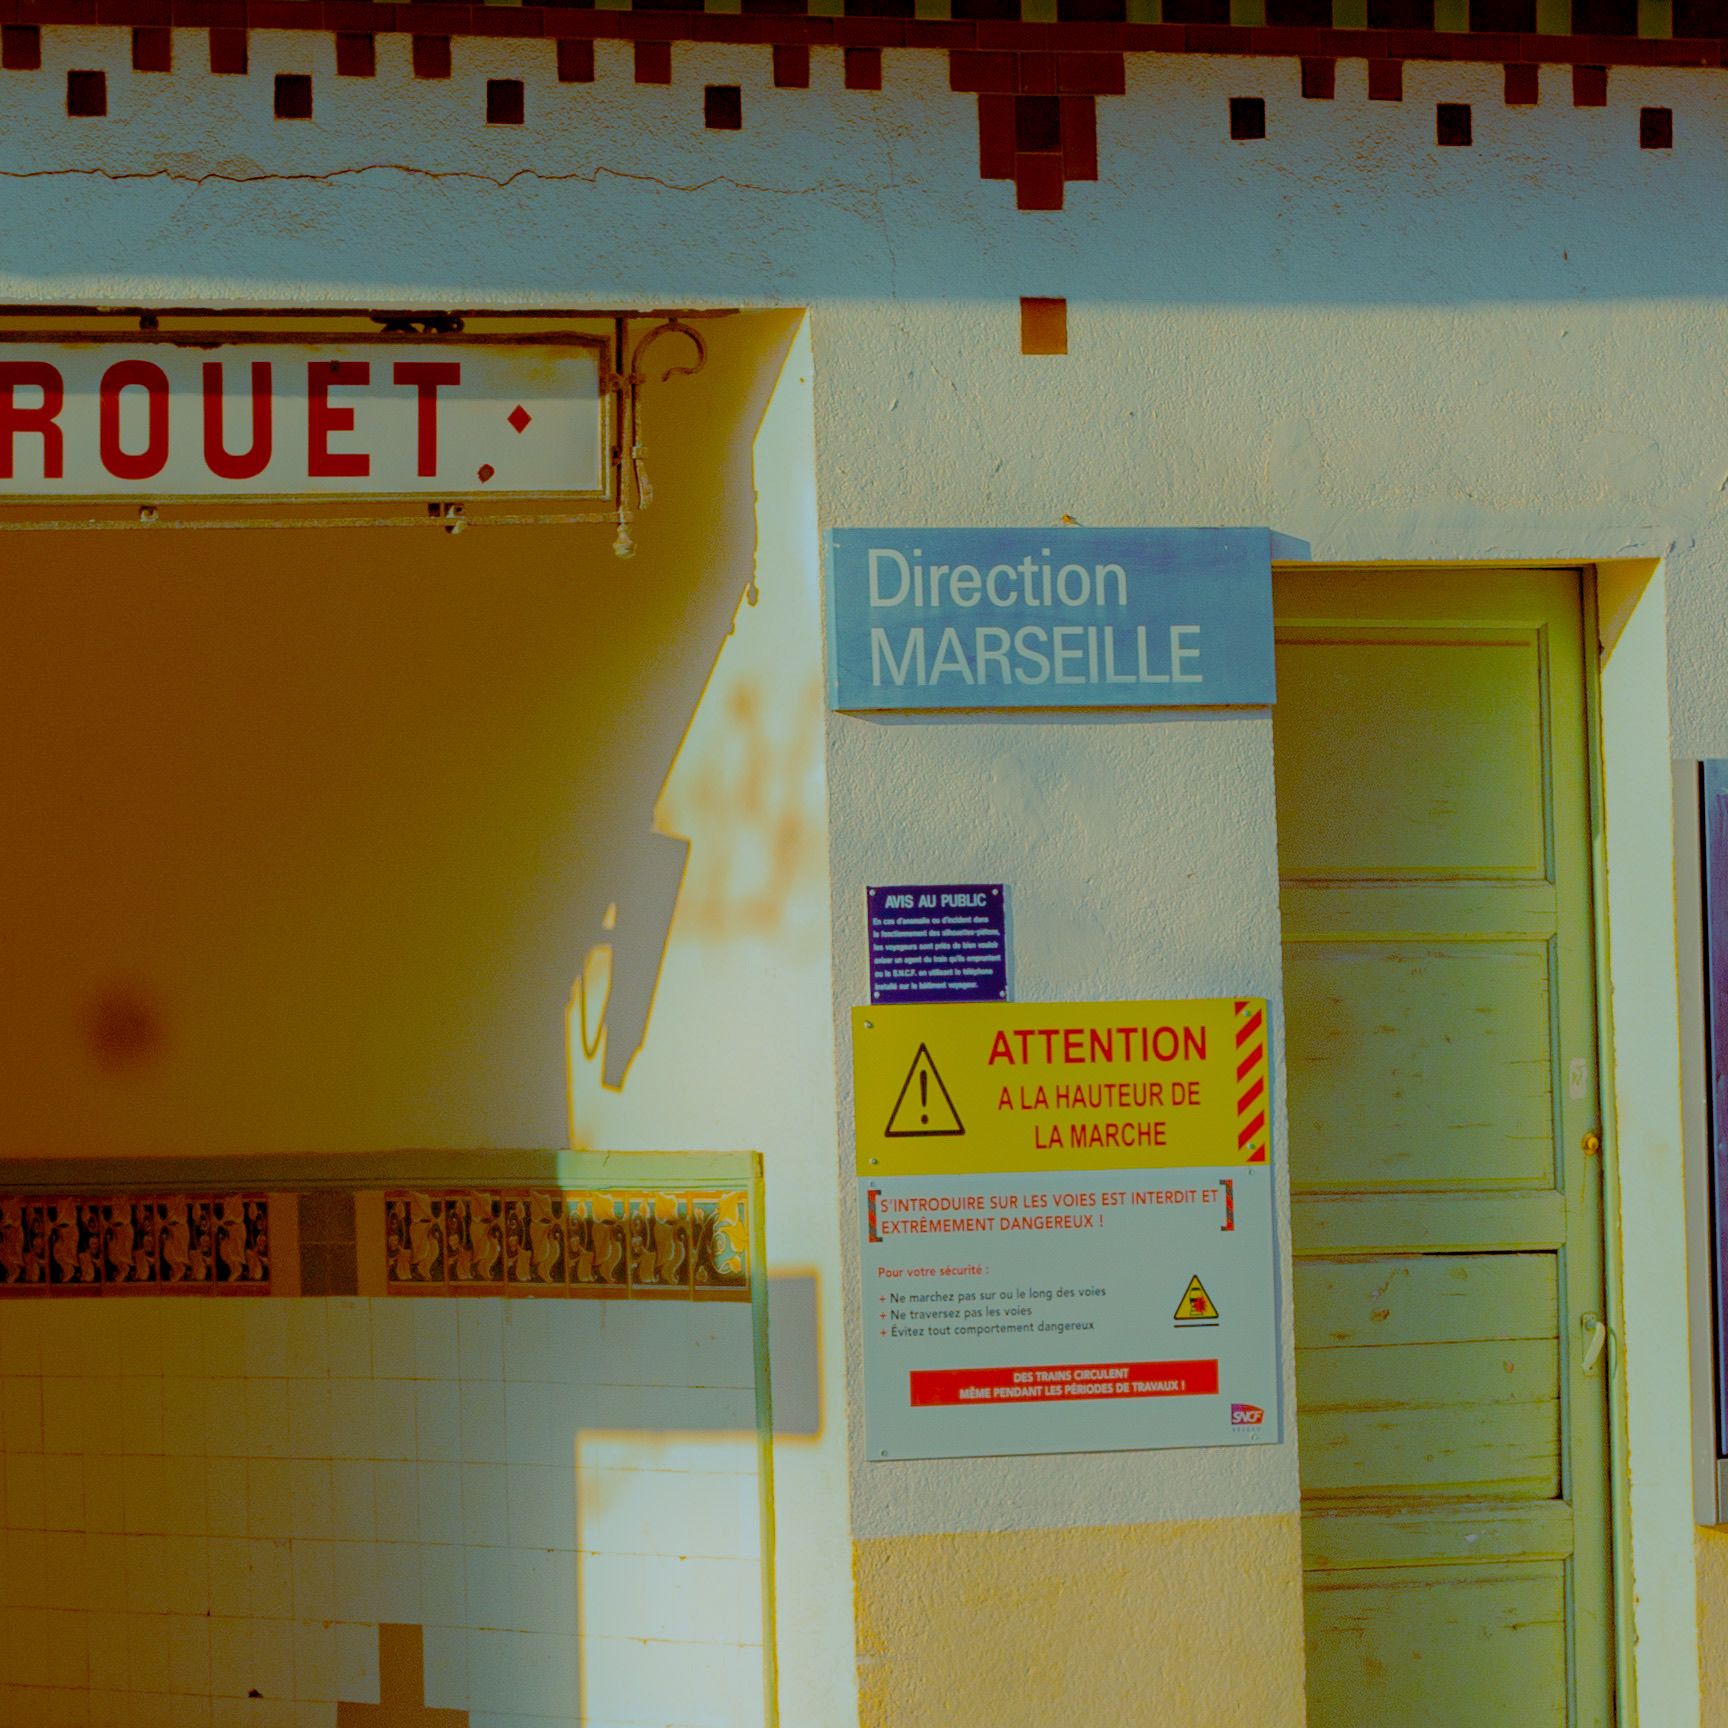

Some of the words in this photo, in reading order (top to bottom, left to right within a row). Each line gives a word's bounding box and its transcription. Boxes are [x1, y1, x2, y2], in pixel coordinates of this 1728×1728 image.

[868, 547, 1128, 608] Direction
[870, 624, 1203, 687] MARSEILLE
[885, 894, 914, 909] AVIS
[918, 894, 936, 908] AU
[940, 893, 987, 908] PUBLIC
[988, 1025, 1207, 1066] ATTENTION
[998, 1086, 1013, 1110] A
[1020, 1084, 1049, 1110] LA
[1056, 1082, 1163, 1109] HAUTEUR
[1171, 1081, 1201, 1106] DE
[1035, 1124, 1063, 1150] LA
[1070, 1121, 1167, 1149] MARCHE
[880, 1196, 984, 1211] S'INTRODUIRE
[990, 1195, 1017, 1208] SUR
[1023, 1194, 1047, 1208] LES
[1052, 1192, 1096, 1207] VOIES
[1102, 1192, 1124, 1205] EST
[1132, 1190, 1194, 1204] INTERDIT
[1202, 1189, 1215, 1203] ET
[882, 1215, 994, 1233] EXTRÊMEMENT
[1000, 1215, 1092, 1231] DANGEREUX
[1100, 1214, 1102, 1229] !
[878, 1266, 902, 1277] Pour
[907, 1266, 936, 1276] votre
[940, 1265, 981, 1275] sécurité
[890, 1291, 905, 1303] Ne
[909, 1290, 954, 1302] marchez
[958, 1292, 976, 1303] pas
[980, 1292, 995, 1300] sur
[999, 1291, 1012, 1299] ou
[1016, 1288, 1025, 1298] le
[1029, 1287, 1052, 1301] long
[1056, 1286, 1074, 1297] des
[1078, 1286, 1105, 1297] voies
[890, 1309, 905, 1318] Ne
[910, 1307, 960, 1319] traversez
[964, 1309, 982, 1320] pas
[986, 1306, 1000, 1316] les
[1004, 1306, 1032, 1316] voies
[891, 1326, 924, 1336] Évitez
[928, 1326, 950, 1335] tout
[954, 1323, 1034, 1336] comportement
[1037, 1321, 1094, 1334] dangereux
[1013, 1371, 1033, 1382] DES
[1035, 1370, 1071, 1381] TRAINS
[1073, 1368, 1128, 1380] CIRCULENT
[993, 1384, 1042, 1396] PENDANT
[1044, 1384, 1062, 1395] LES
[1115, 1382, 1129, 1392] DE
[1131, 1380, 1178, 1392] TRAVAUX
[1180, 1380, 1185, 1391] !
[1232, 1411, 1262, 1423] SNCF
